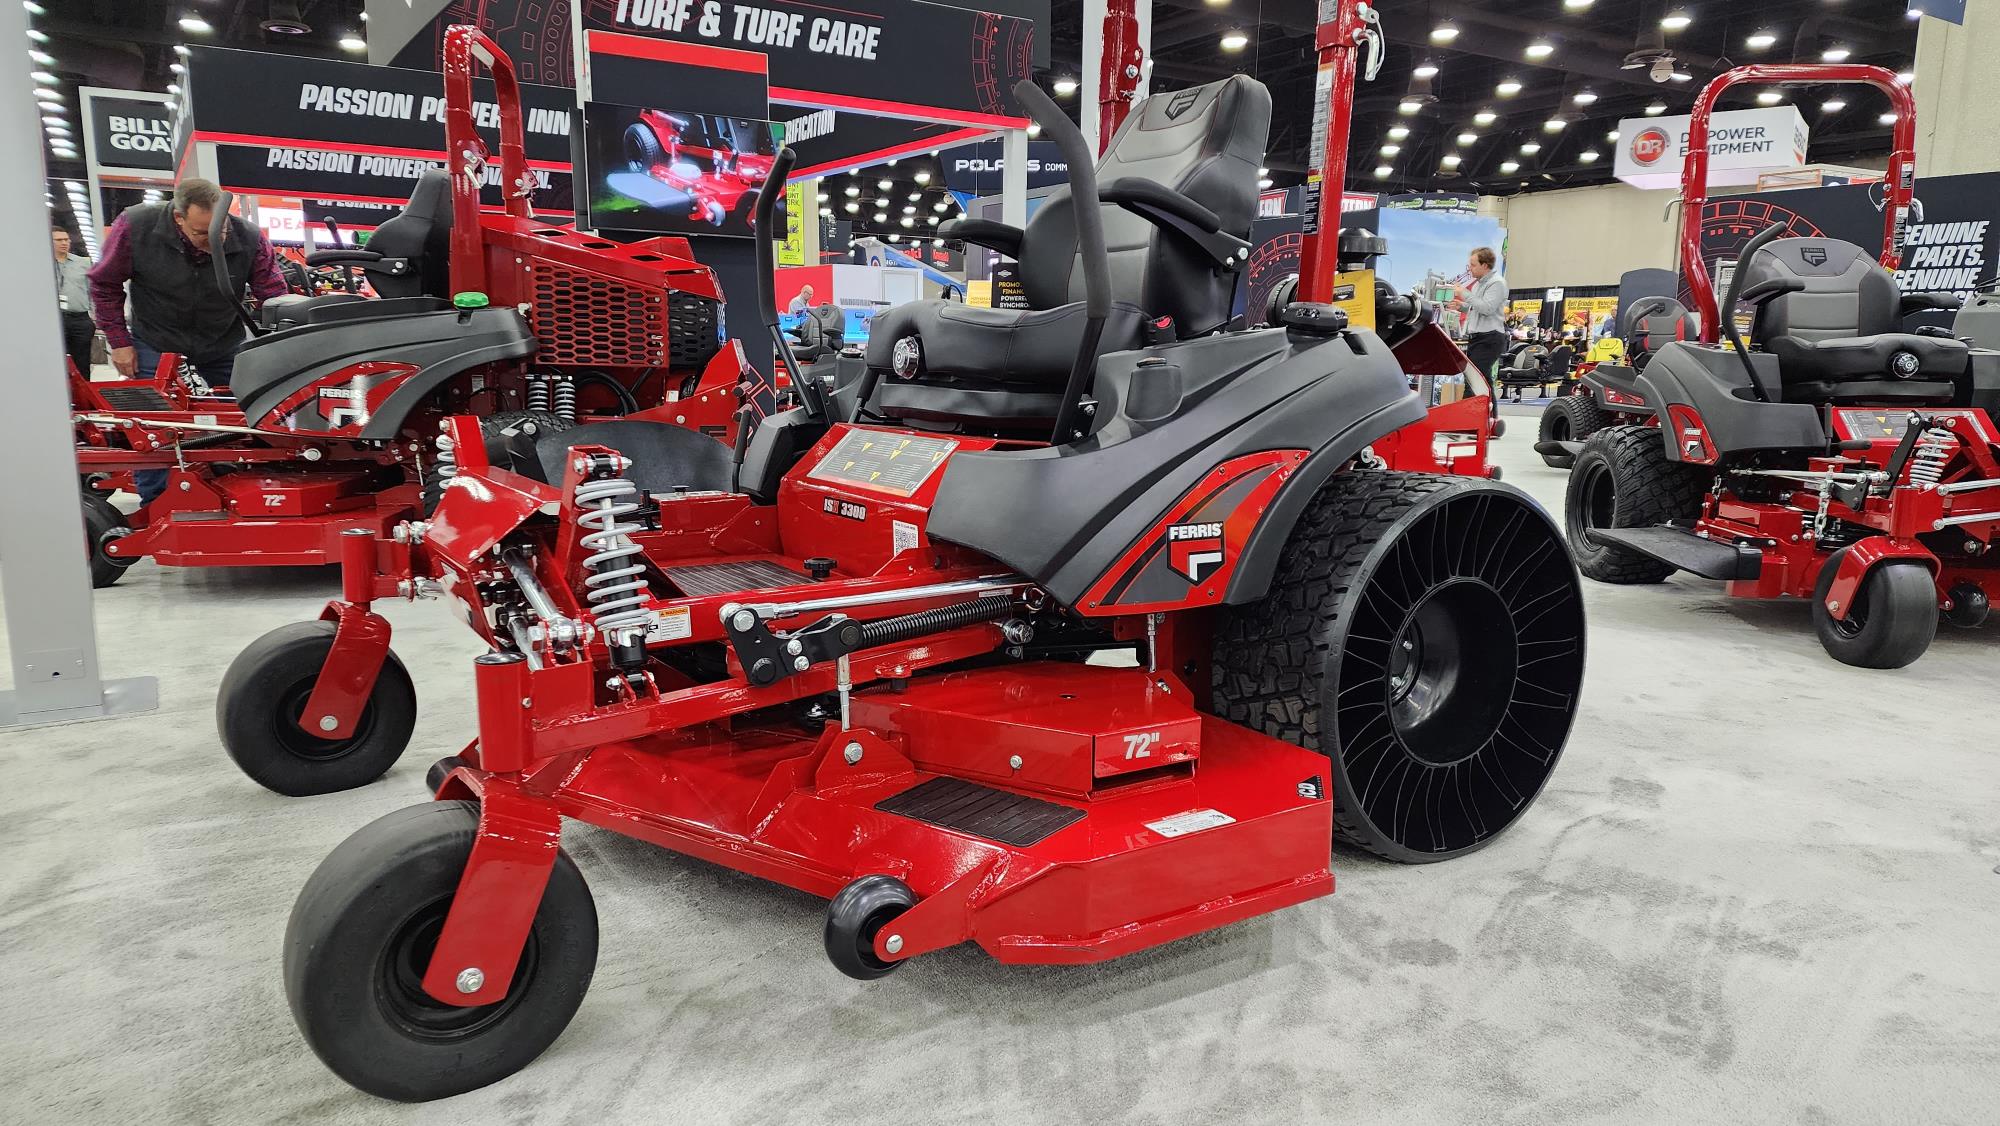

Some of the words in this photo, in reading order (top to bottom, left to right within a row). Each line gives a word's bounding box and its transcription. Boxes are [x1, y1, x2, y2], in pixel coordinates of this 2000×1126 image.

[698, 1, 722, 37] &
[732, 5, 804, 48] TURF
[808, 18, 881, 61] CARE
[299, 83, 414, 121] PASSION
[110, 133, 171, 153] GOA
[1708, 126, 1766, 140] POWER
[266, 149, 354, 171] PASSION
[1679, 140, 1774, 158] EIPMENT
[1904, 220, 1990, 246] GENUINE
[1910, 244, 1985, 268] PARTS.
[1892, 267, 1982, 291] GENUINE
[319, 387, 363, 398] FERRIS
[840, 502, 867, 520] 3300
[1169, 522, 1223, 540] FERRIS
[1123, 732, 1161, 760] 72"
